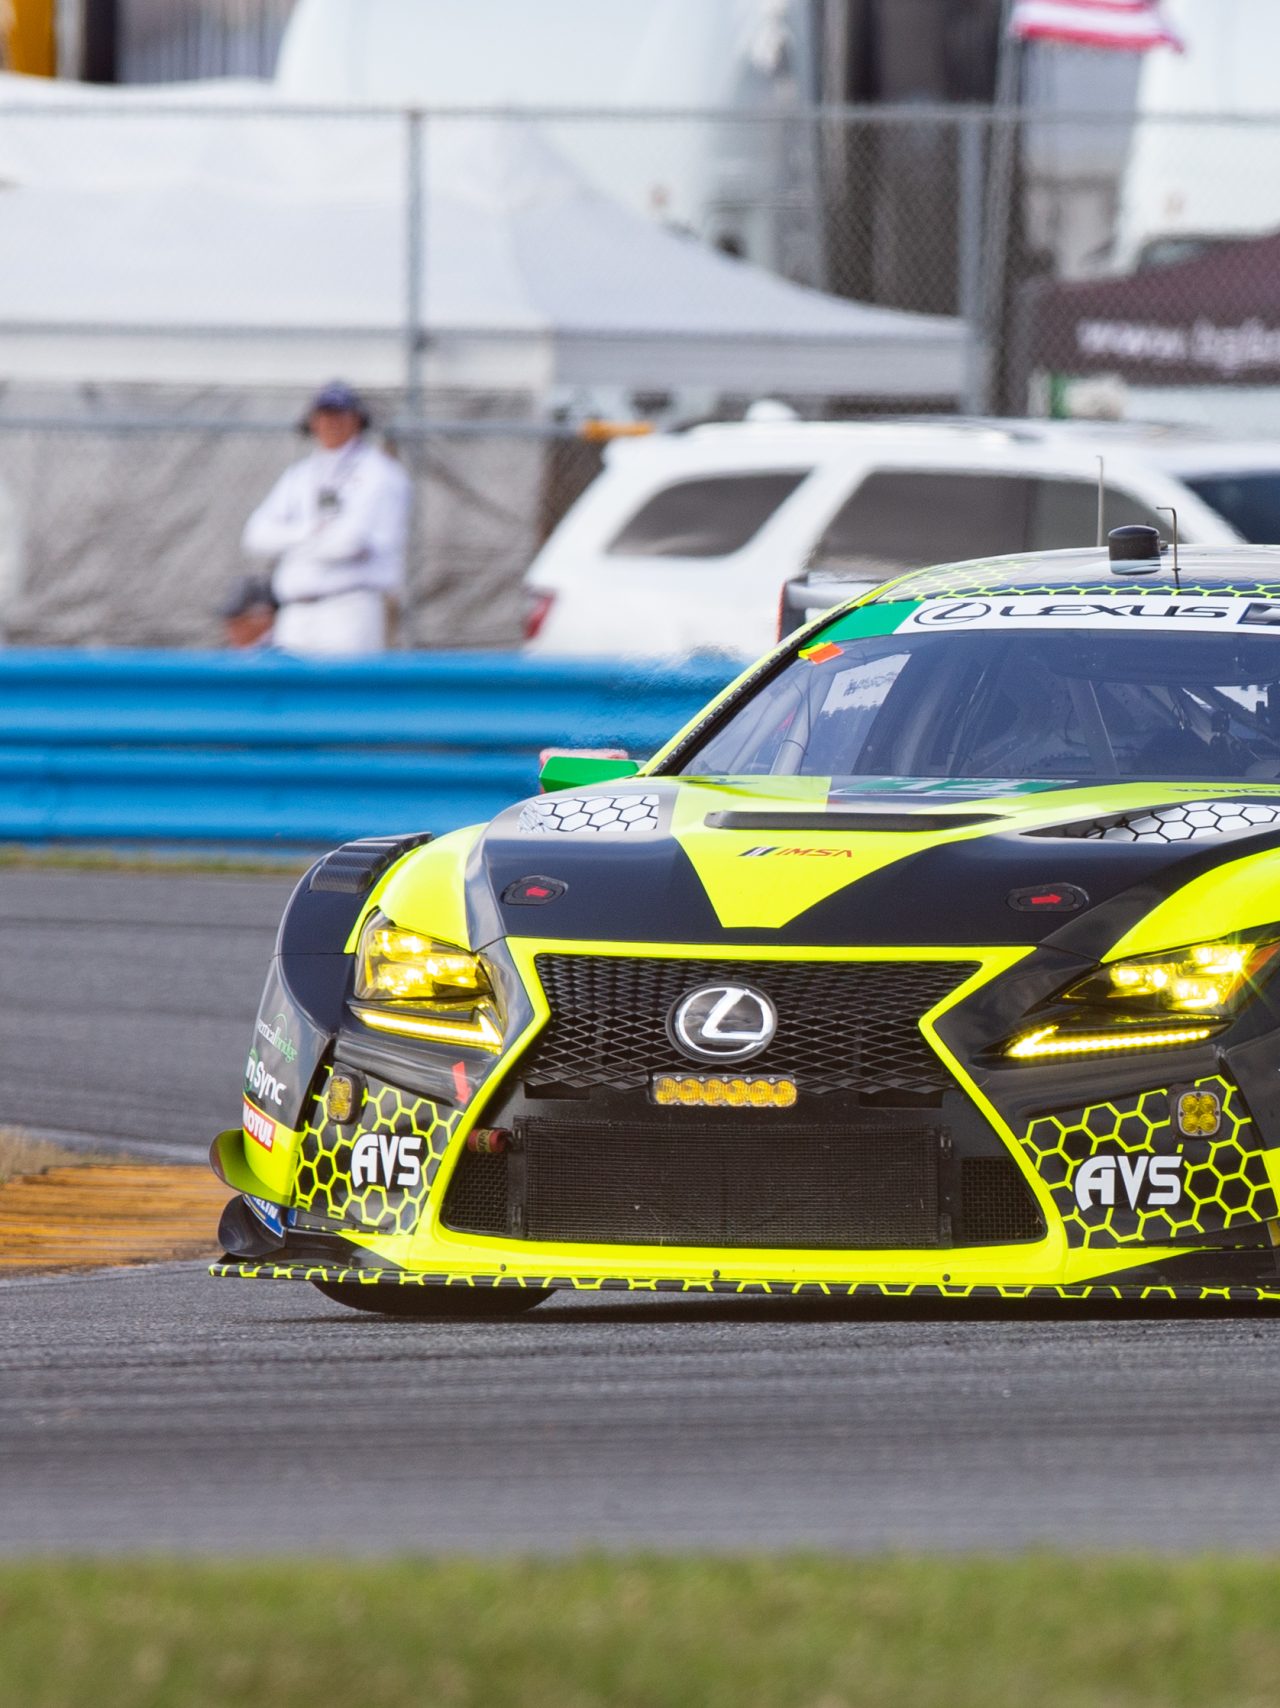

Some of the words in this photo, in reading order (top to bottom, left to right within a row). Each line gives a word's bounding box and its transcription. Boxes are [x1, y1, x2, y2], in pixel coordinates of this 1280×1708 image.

[1001, 606, 1229, 619] LEXUS
[776, 848, 853, 858] IMSA
[351, 1134, 422, 1190] AVS
[1075, 1155, 1183, 1211] AVS
